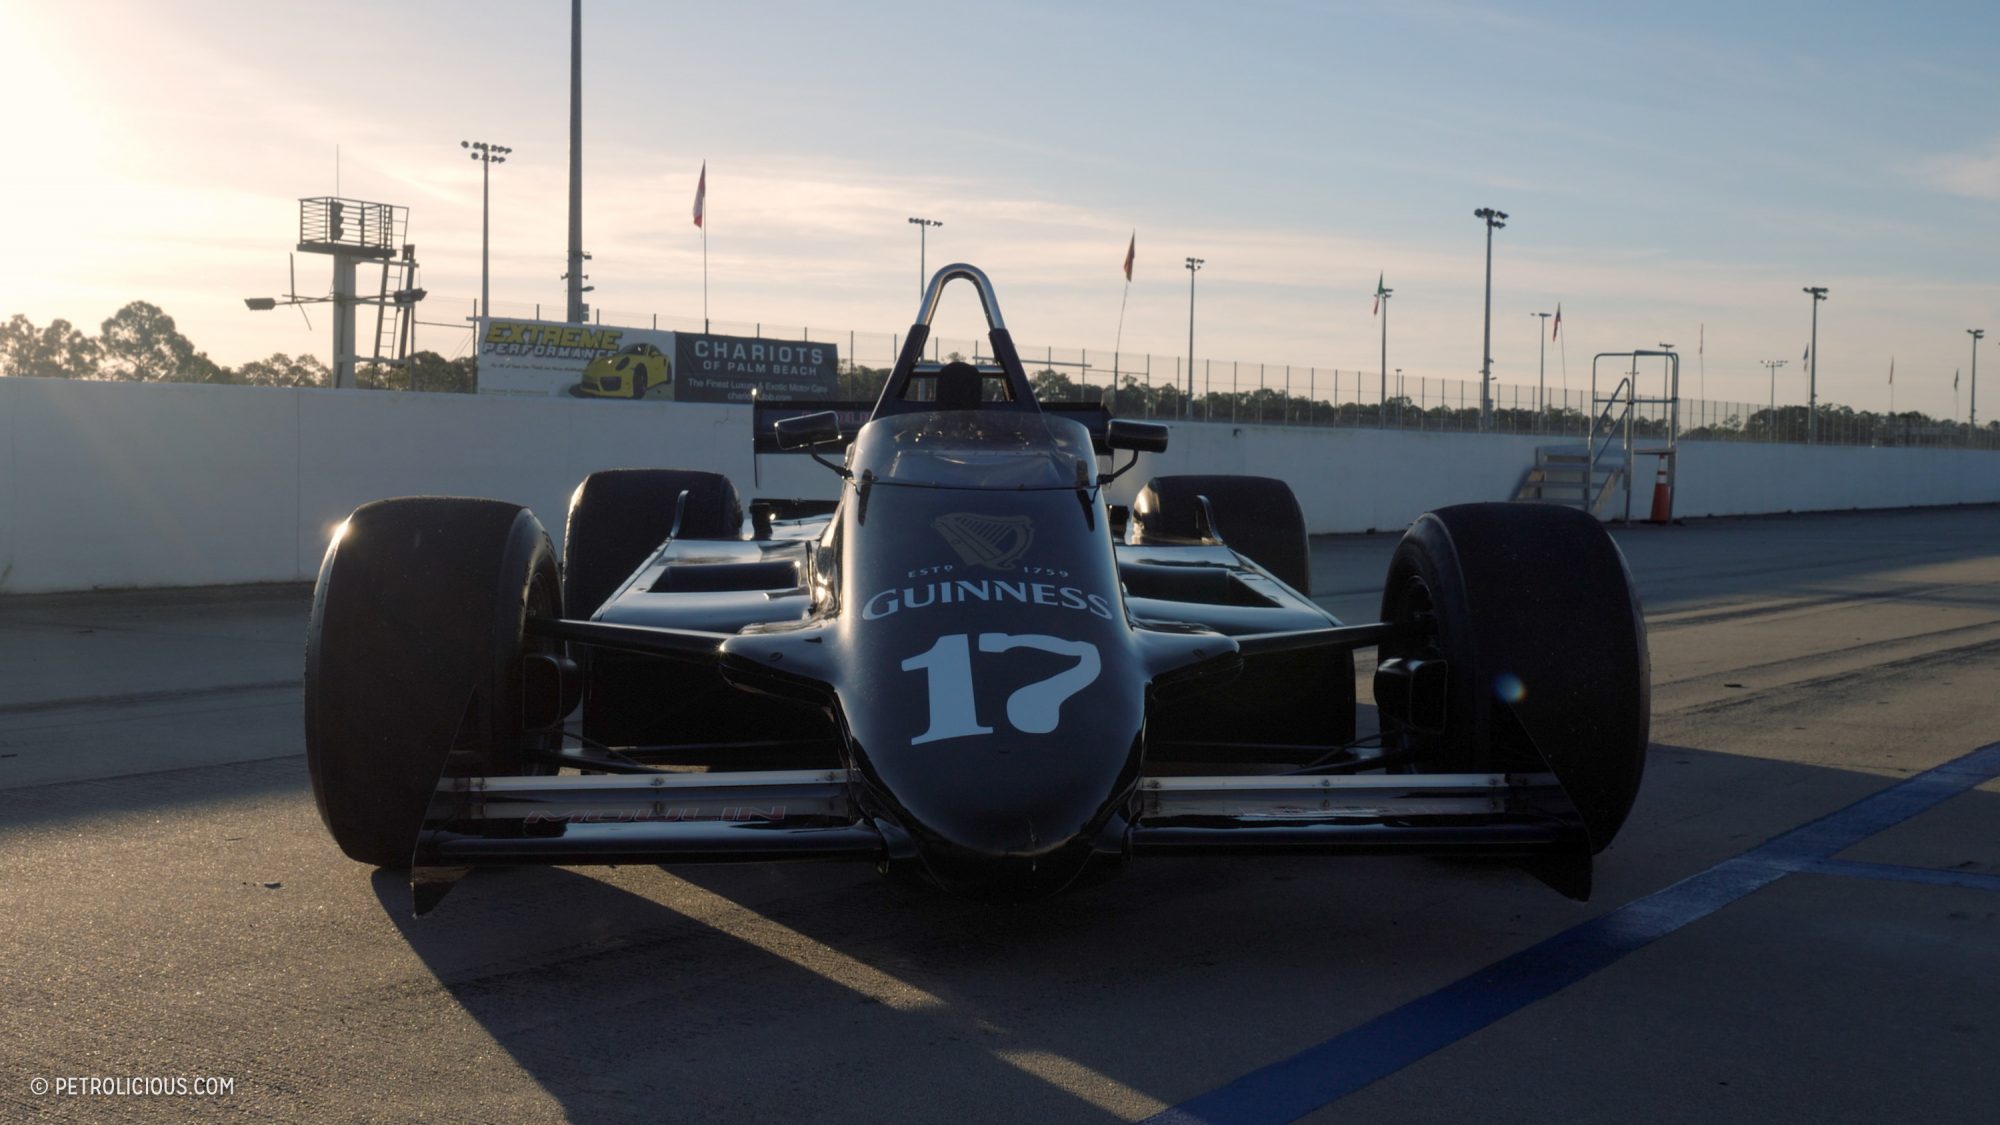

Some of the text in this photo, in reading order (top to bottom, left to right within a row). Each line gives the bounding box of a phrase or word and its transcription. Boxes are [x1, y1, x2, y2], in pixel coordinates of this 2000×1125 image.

[485, 321, 623, 350] EXTREME
[482, 342, 617, 360] PERFORMANCE
[695, 340, 823, 365] CHARIOTS
[703, 360, 817, 376] OF PALM BEACH
[688, 378, 704, 387] The
[1024, 566, 1068, 578] 1759
[862, 580, 1113, 620] GUINNESS
[901, 632, 1101, 745] 17
